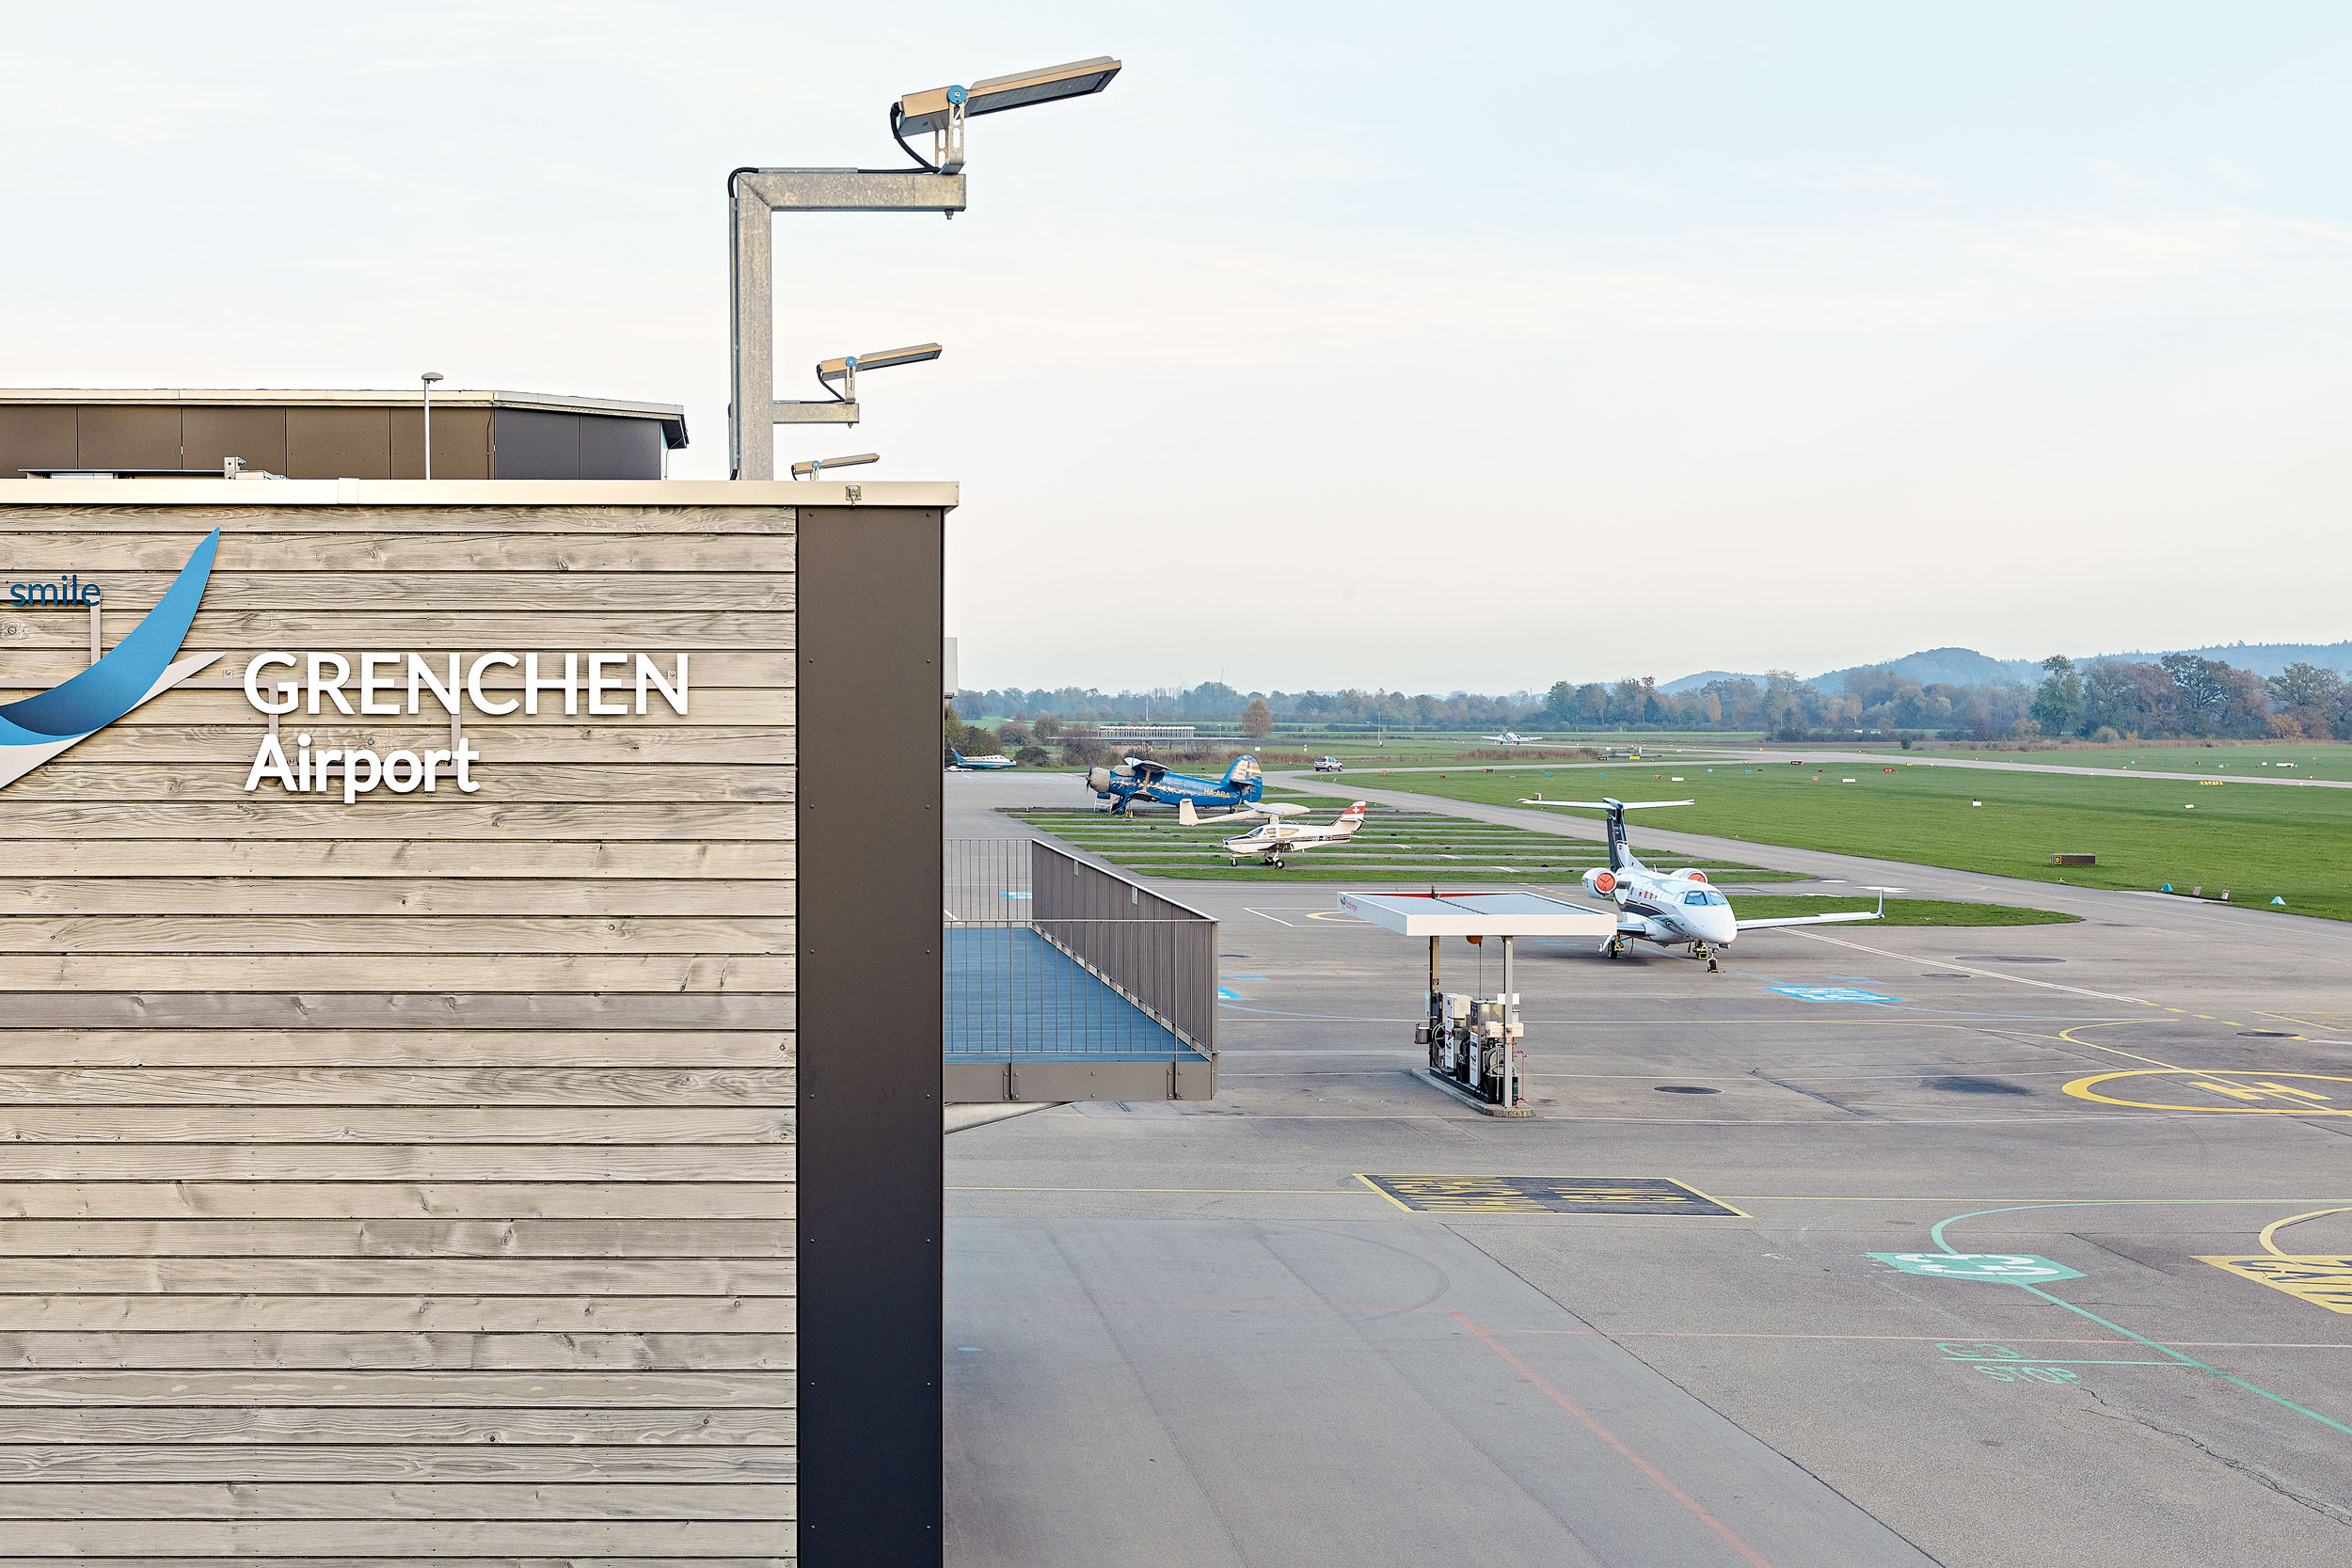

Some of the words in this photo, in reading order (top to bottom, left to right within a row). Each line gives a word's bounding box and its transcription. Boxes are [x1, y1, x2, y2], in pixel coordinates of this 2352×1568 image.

[10, 575, 101, 607] smile
[244, 652, 689, 715] GRENCHEN
[244, 734, 481, 804] Airport
[1204, 788, 1231, 799] HA-ABA
[1973, 1365, 2080, 1385] STOP
